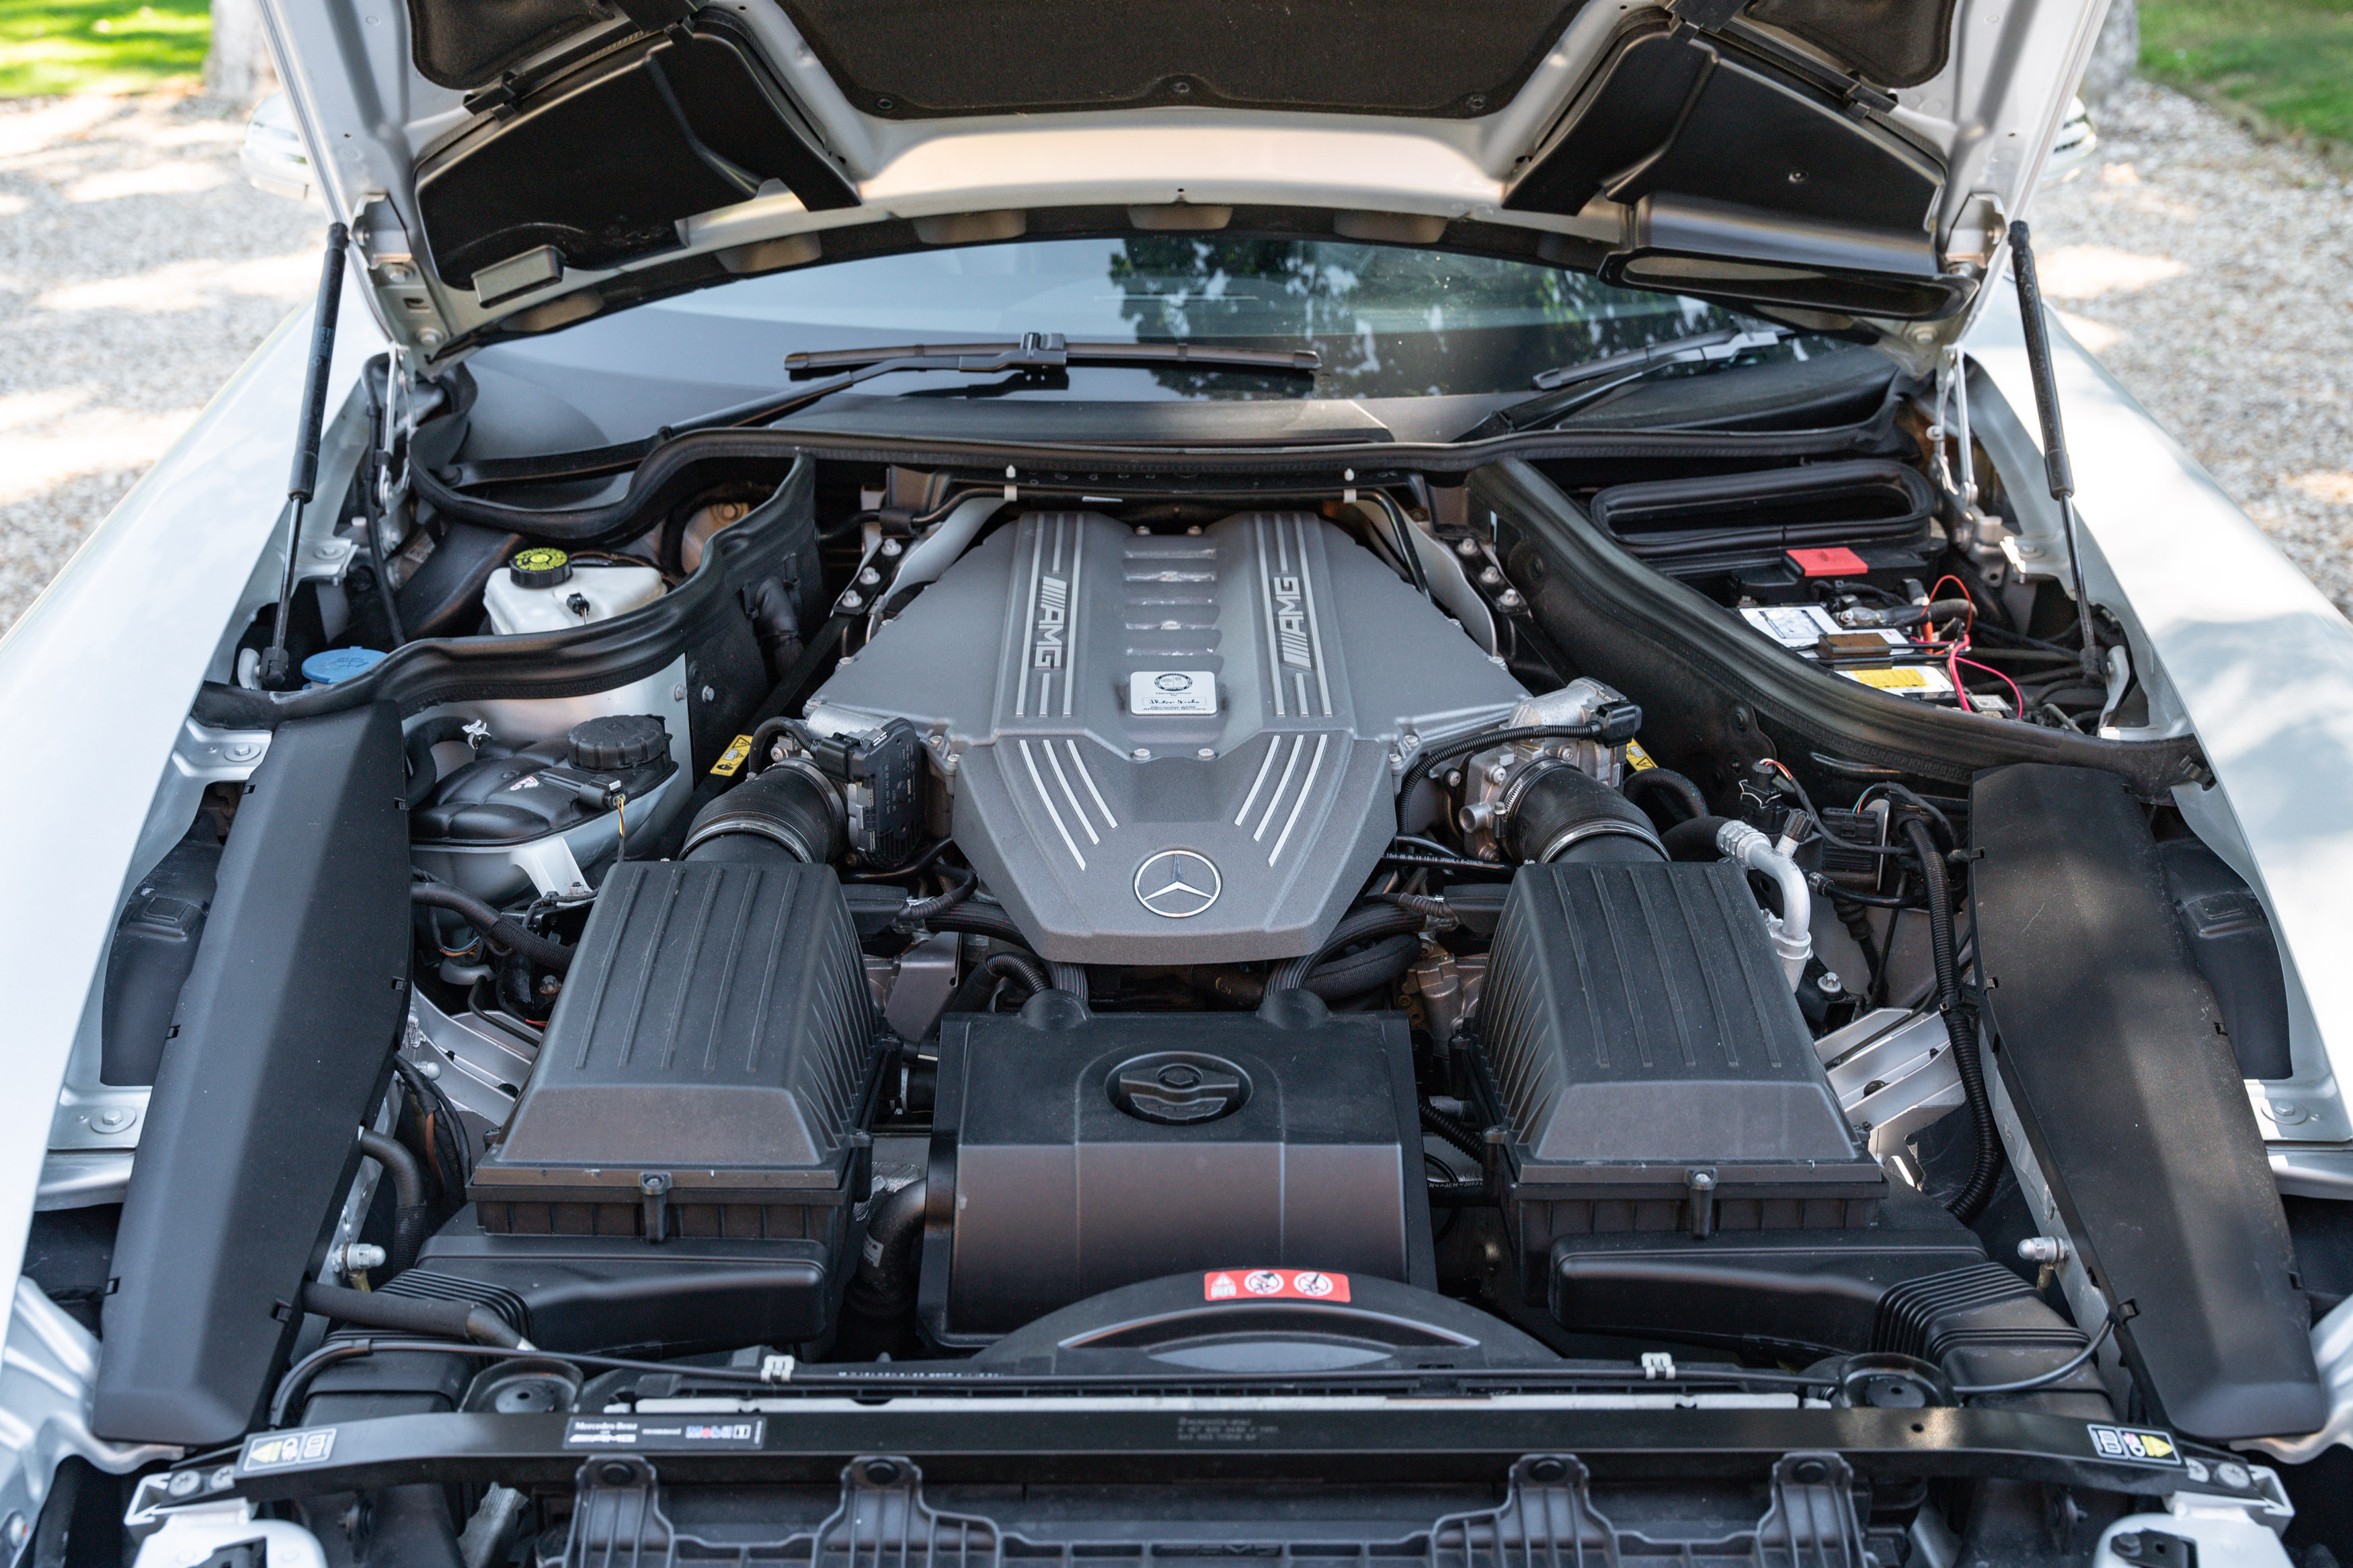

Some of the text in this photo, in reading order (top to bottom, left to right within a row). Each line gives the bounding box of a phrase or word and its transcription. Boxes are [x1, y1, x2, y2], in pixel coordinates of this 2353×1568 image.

[1034, 601, 1066, 669] AMG
[1273, 577, 1306, 636] AMG
[685, 1424, 733, 1439] Mobil
